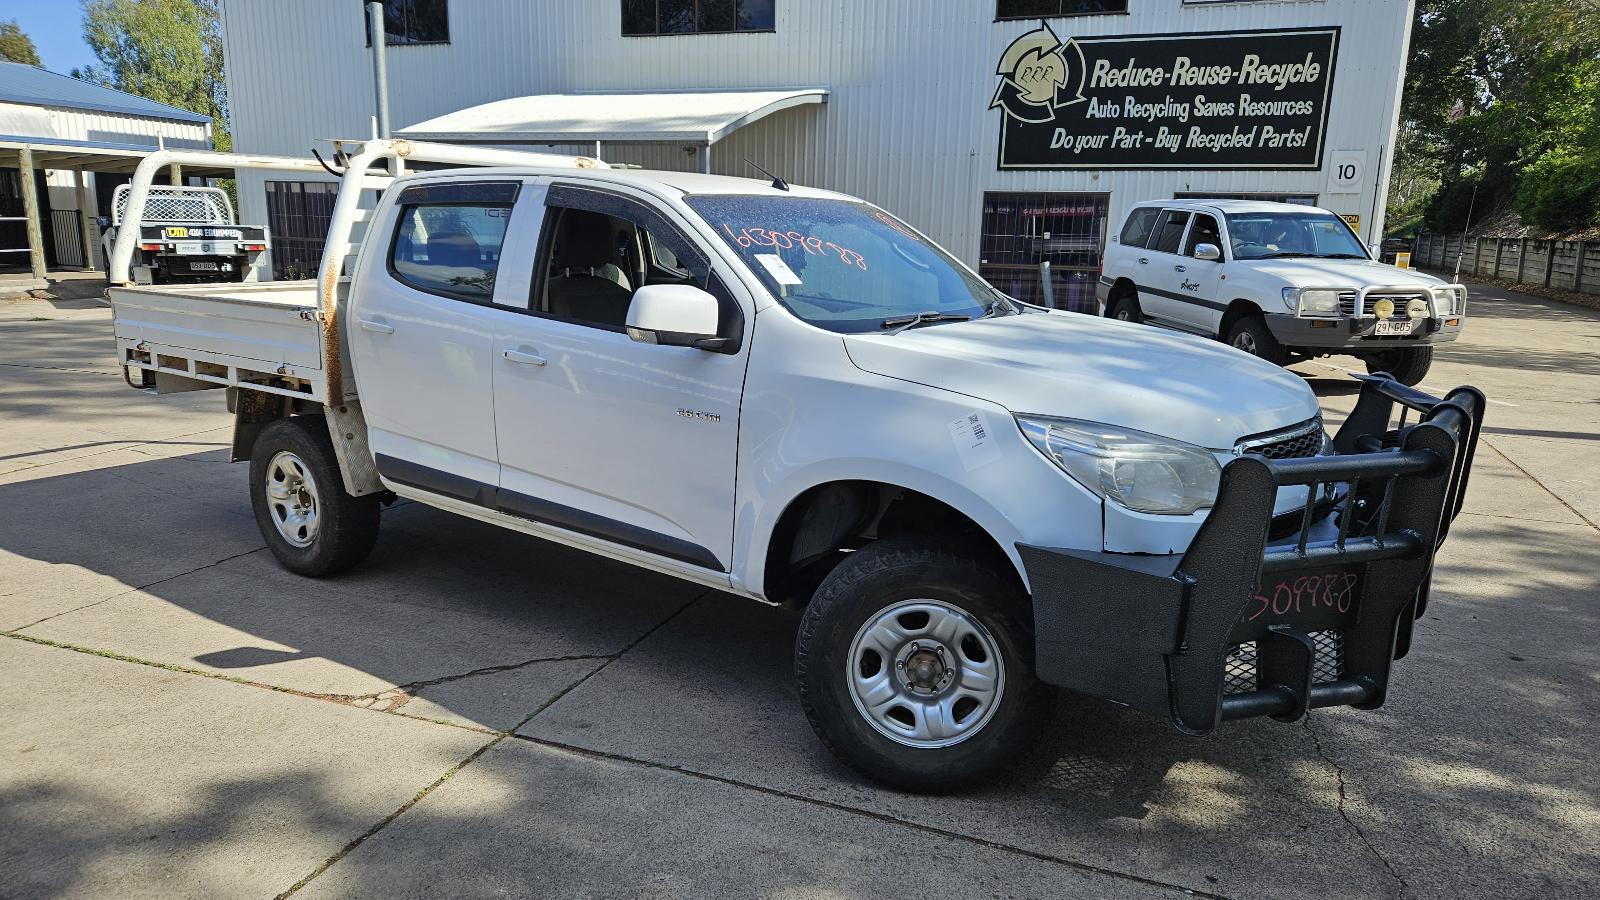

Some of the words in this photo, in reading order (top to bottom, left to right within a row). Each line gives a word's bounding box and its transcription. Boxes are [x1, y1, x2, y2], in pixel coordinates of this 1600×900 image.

[1090, 51, 1321, 91] Reduce-Reuse-Recycle
[1086, 96, 1120, 119] Auto
[1123, 95, 1190, 122] Recycling
[1193, 94, 1236, 117] Saves
[1238, 93, 1314, 117] Resources
[1050, 127, 1074, 149] Do
[1073, 135, 1110, 154] your
[1110, 126, 1144, 149] Part
[1154, 126, 1182, 153] Buy
[1185, 125, 1258, 153] Recycled
[1258, 125, 1312, 149] Parts!
[1338, 164, 1356, 180] 10
[1245, 572, 1358, 622] 309988
